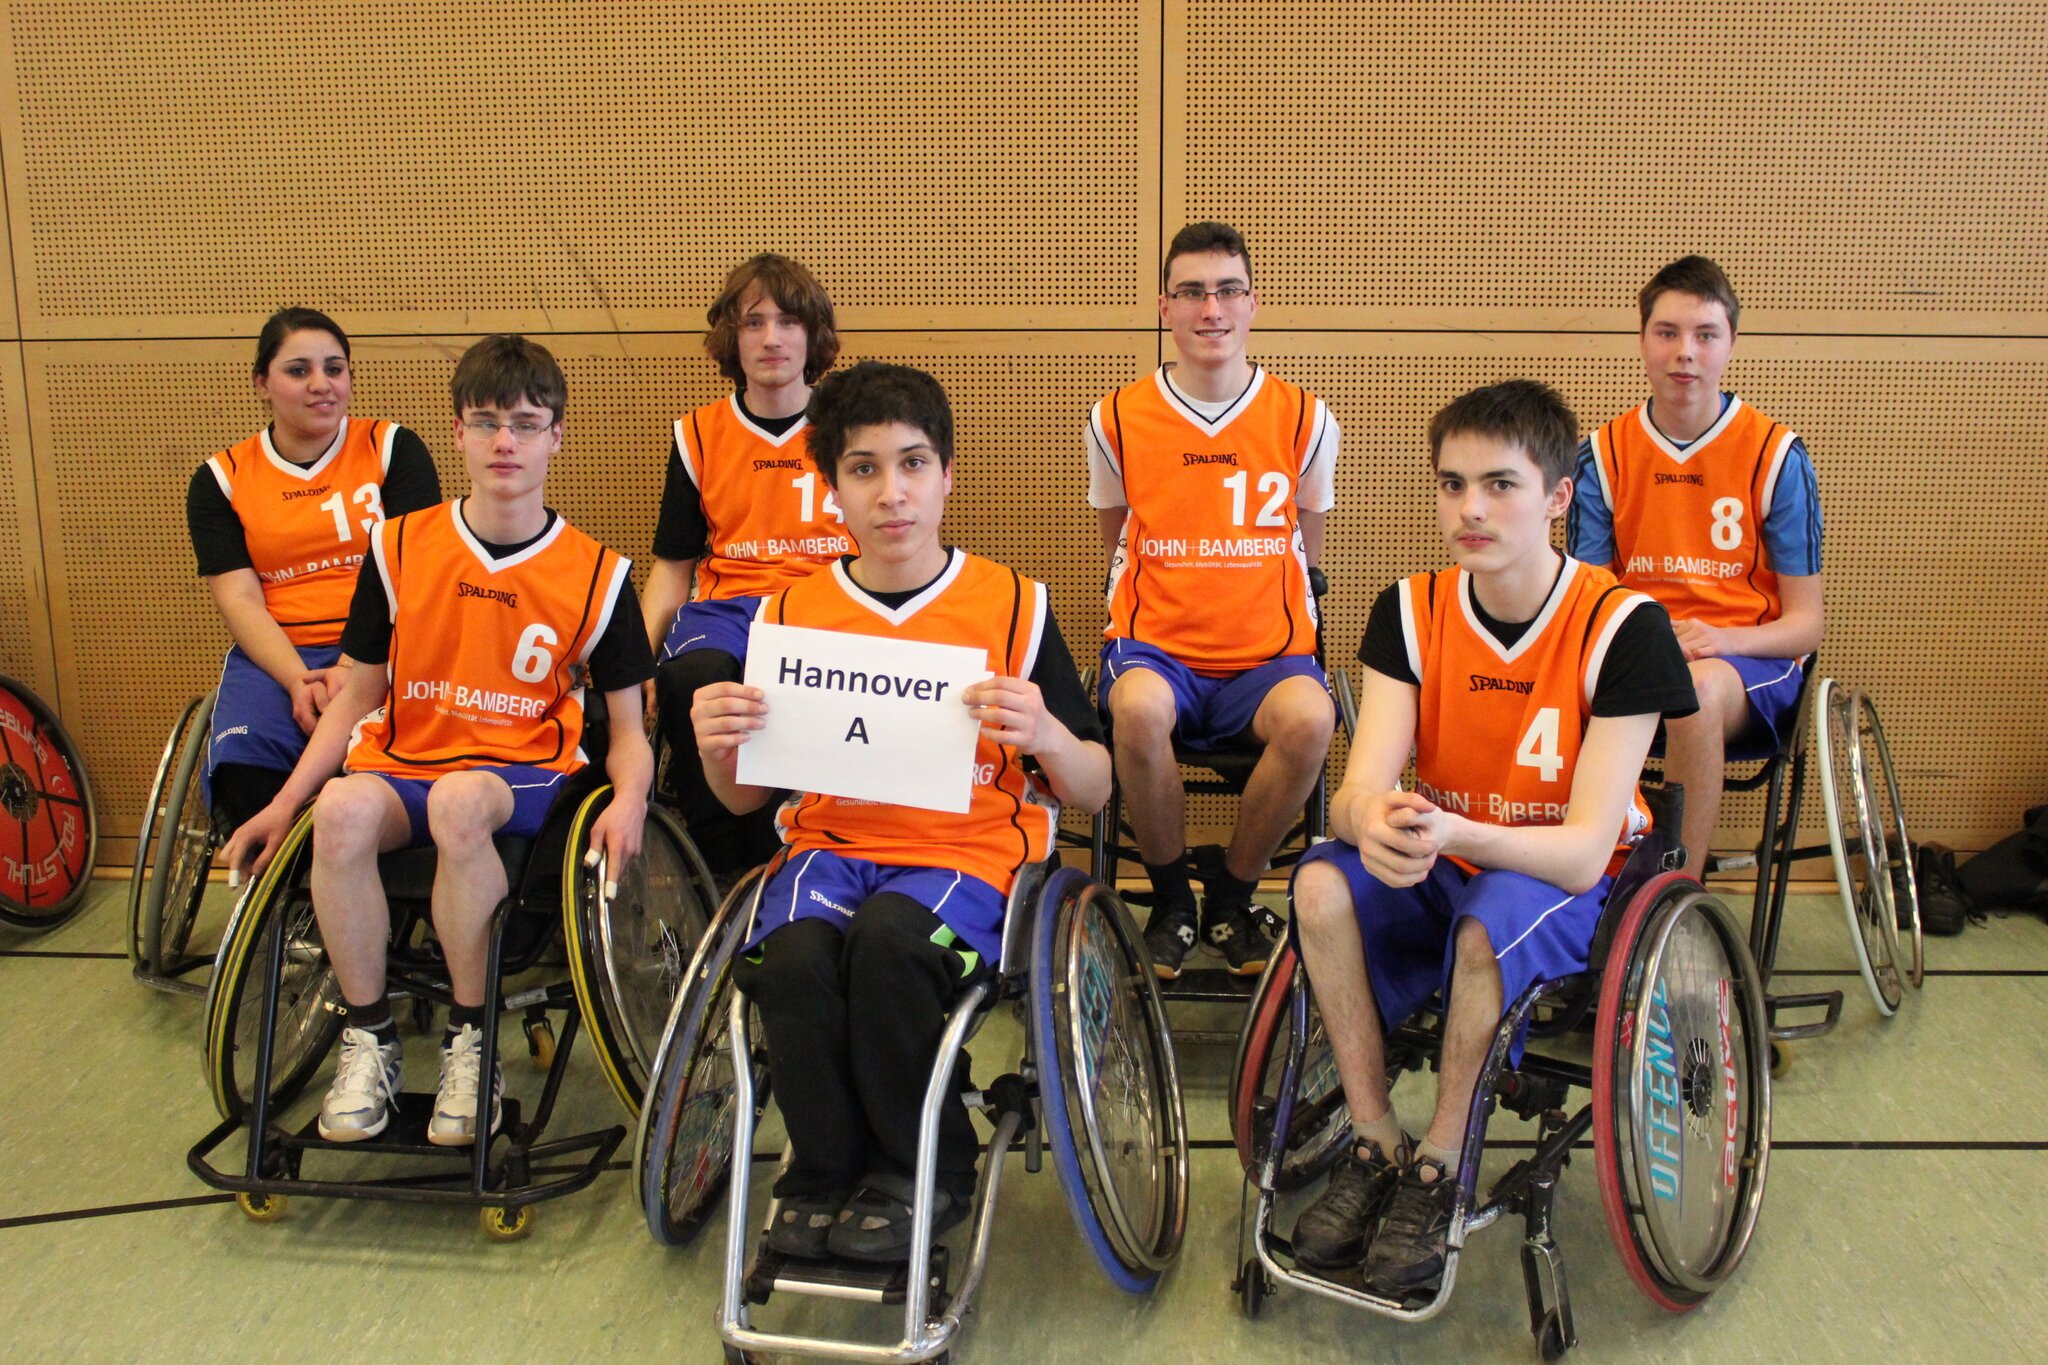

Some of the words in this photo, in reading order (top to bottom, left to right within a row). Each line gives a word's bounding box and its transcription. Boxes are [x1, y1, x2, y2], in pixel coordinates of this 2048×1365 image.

[753, 459, 803, 472] SPALDING
[1183, 453, 1238, 466] SPALDING
[1655, 473, 1704, 487] SPALDING
[320, 482, 385, 542] 13
[792, 472, 844, 523] 14
[1223, 470, 1290, 527] 12
[1711, 496, 1744, 550] 8
[768, 536, 849, 556] BAMBERG
[1140, 539, 1186, 557] JOHN
[1200, 537, 1286, 557] BAMBERG
[1664, 556, 1744, 579] BAMBERG
[458, 582, 518, 609] SPALDING
[511, 623, 558, 684] 6
[778, 656, 949, 702] Hannover
[455, 685, 547, 718] BAMBERG
[844, 716, 869, 745] A
[1516, 707, 1564, 782] 4
